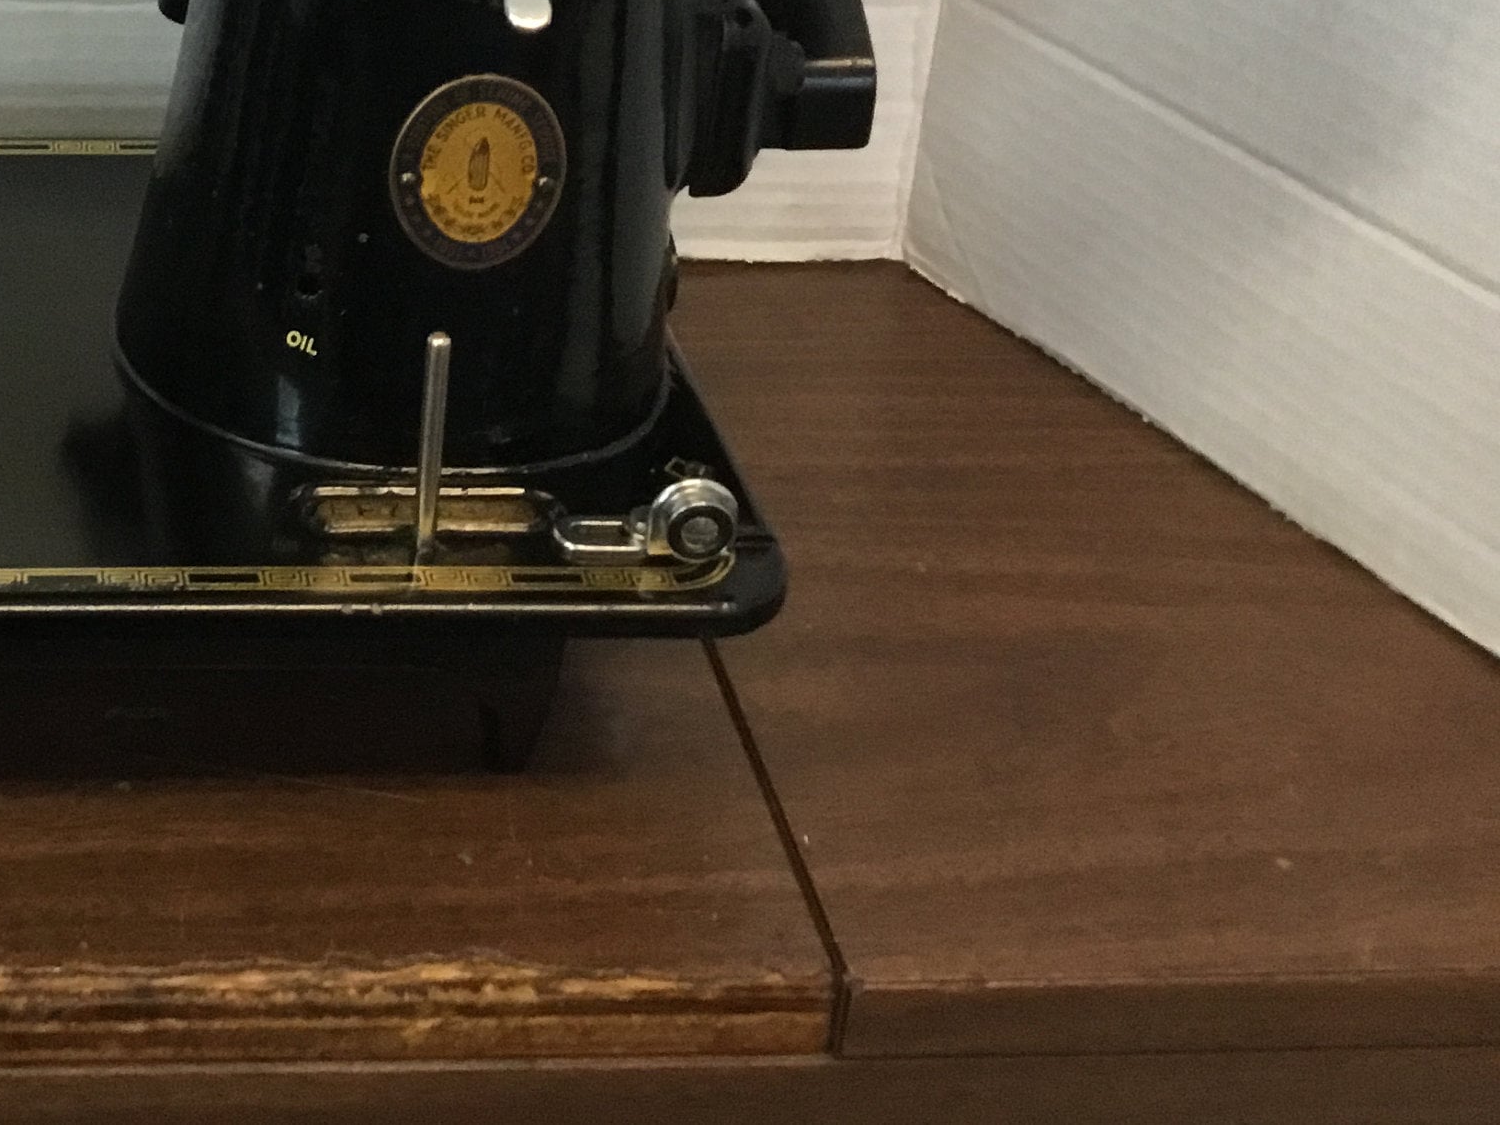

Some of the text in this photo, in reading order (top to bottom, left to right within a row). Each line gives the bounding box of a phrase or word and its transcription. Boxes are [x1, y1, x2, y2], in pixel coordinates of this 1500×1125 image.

[421, 144, 441, 170] THE
[436, 106, 486, 142] SINGER
[286, 330, 318, 356] OIL
